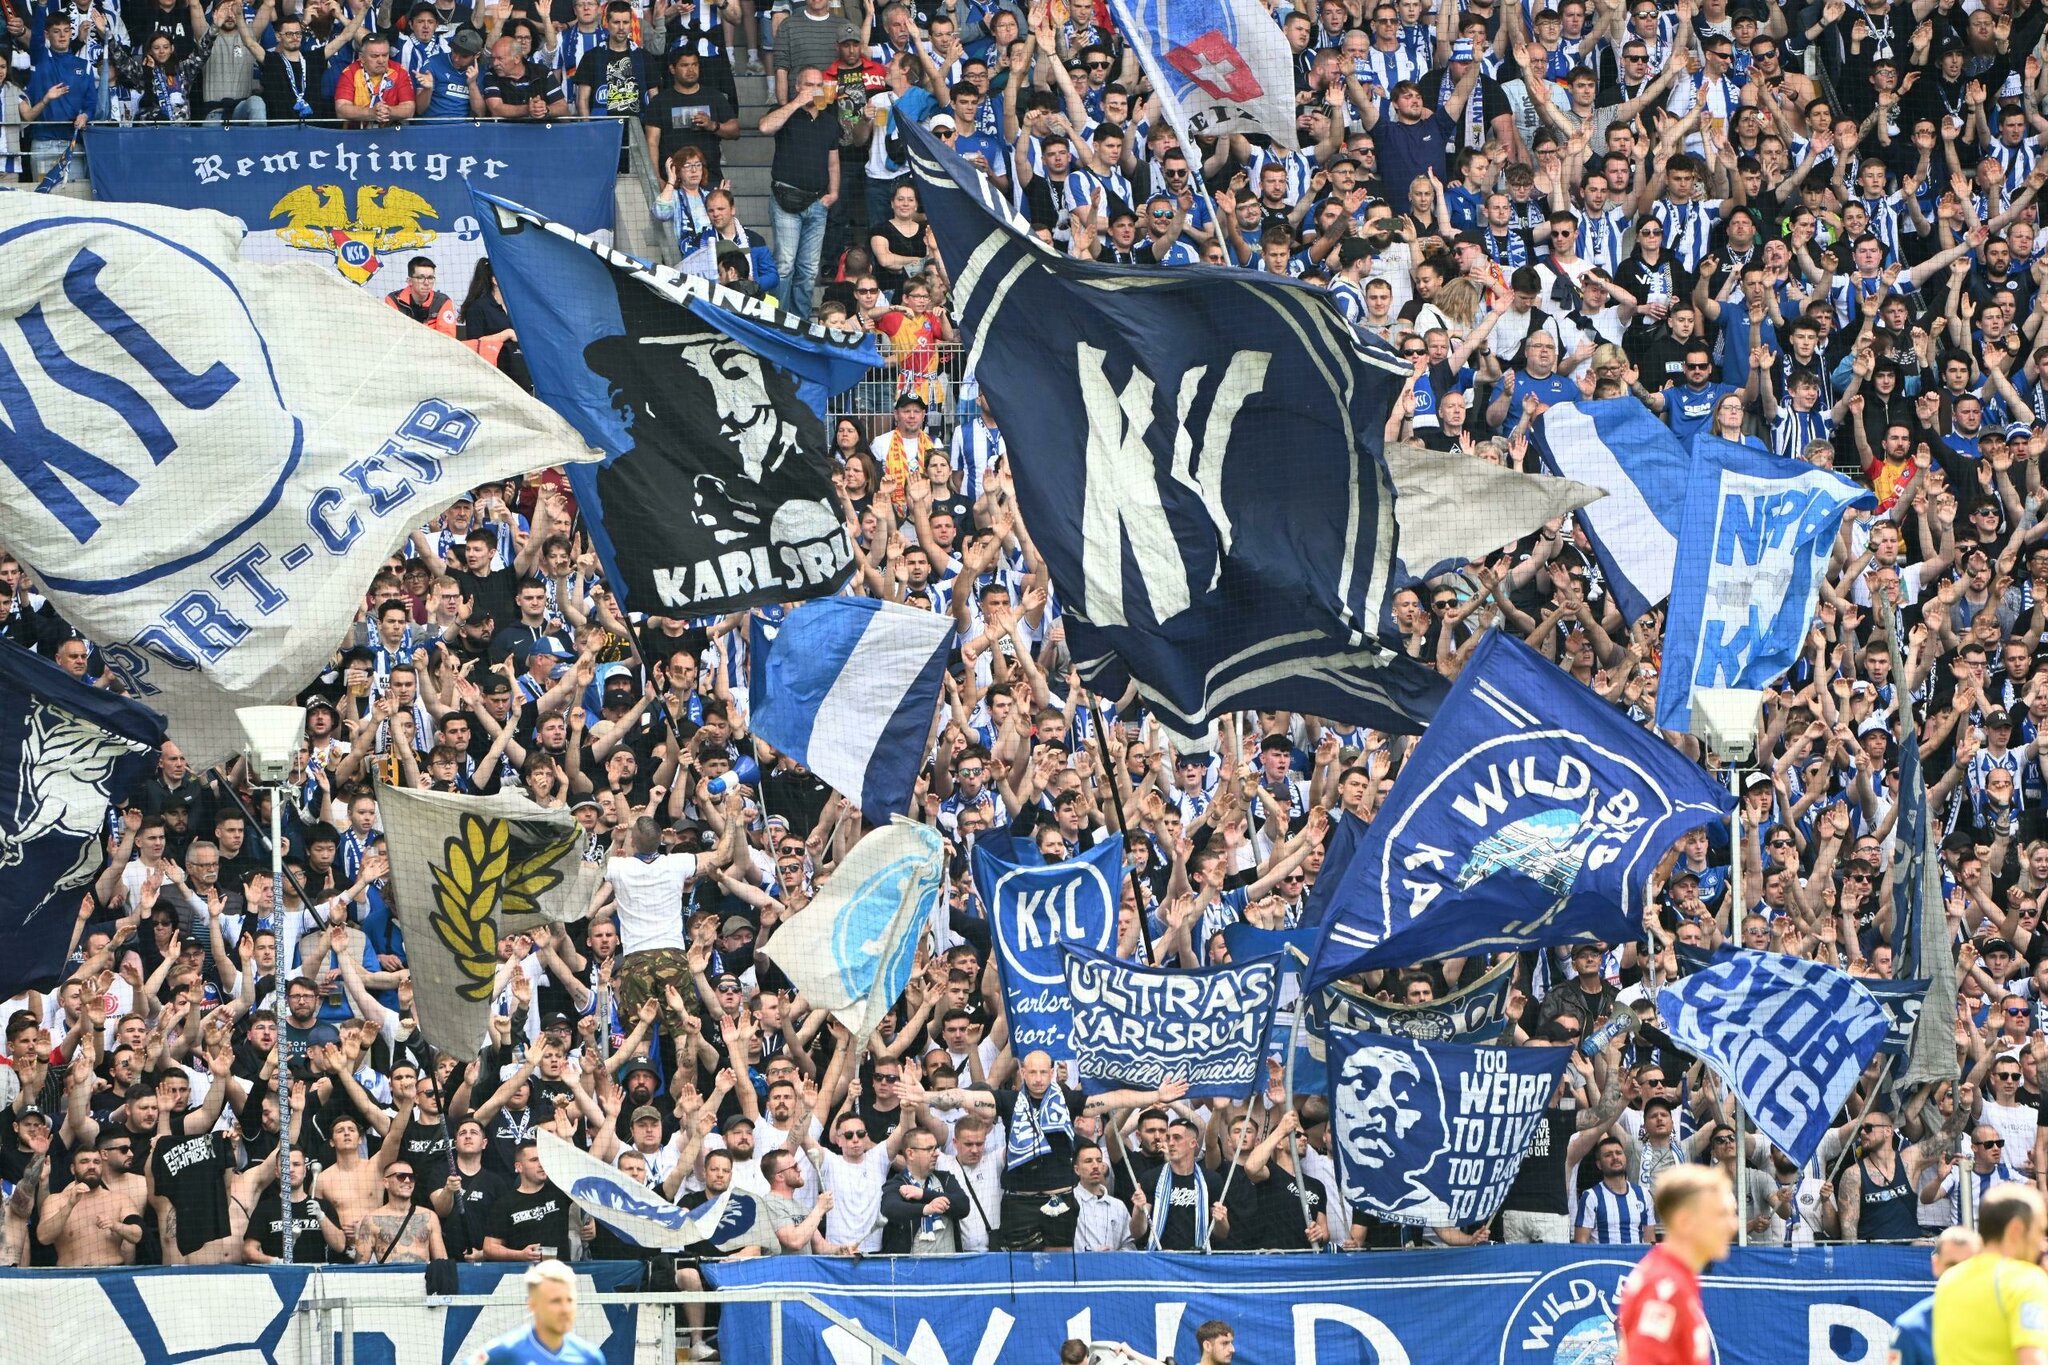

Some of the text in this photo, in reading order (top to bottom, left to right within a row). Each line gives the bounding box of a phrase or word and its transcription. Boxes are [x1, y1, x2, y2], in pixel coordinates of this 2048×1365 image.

[193, 143, 508, 184] Remchinger
[346, 244, 367, 262] KSC
[1451, 755, 1592, 827] WILD
[1016, 877, 1086, 951] KSC
[1068, 958, 1273, 1020] ULTRAS
[1474, 1048, 1508, 1073] TOO
[1460, 1072, 1552, 1115] WEIRD
[1452, 1117, 1486, 1154] TO
[1449, 1158, 1485, 1186] TOO
[1402, 1214, 1427, 1226] BOYS
[1448, 1189, 1476, 1227] TO
[1522, 1279, 1597, 1350] WILD
